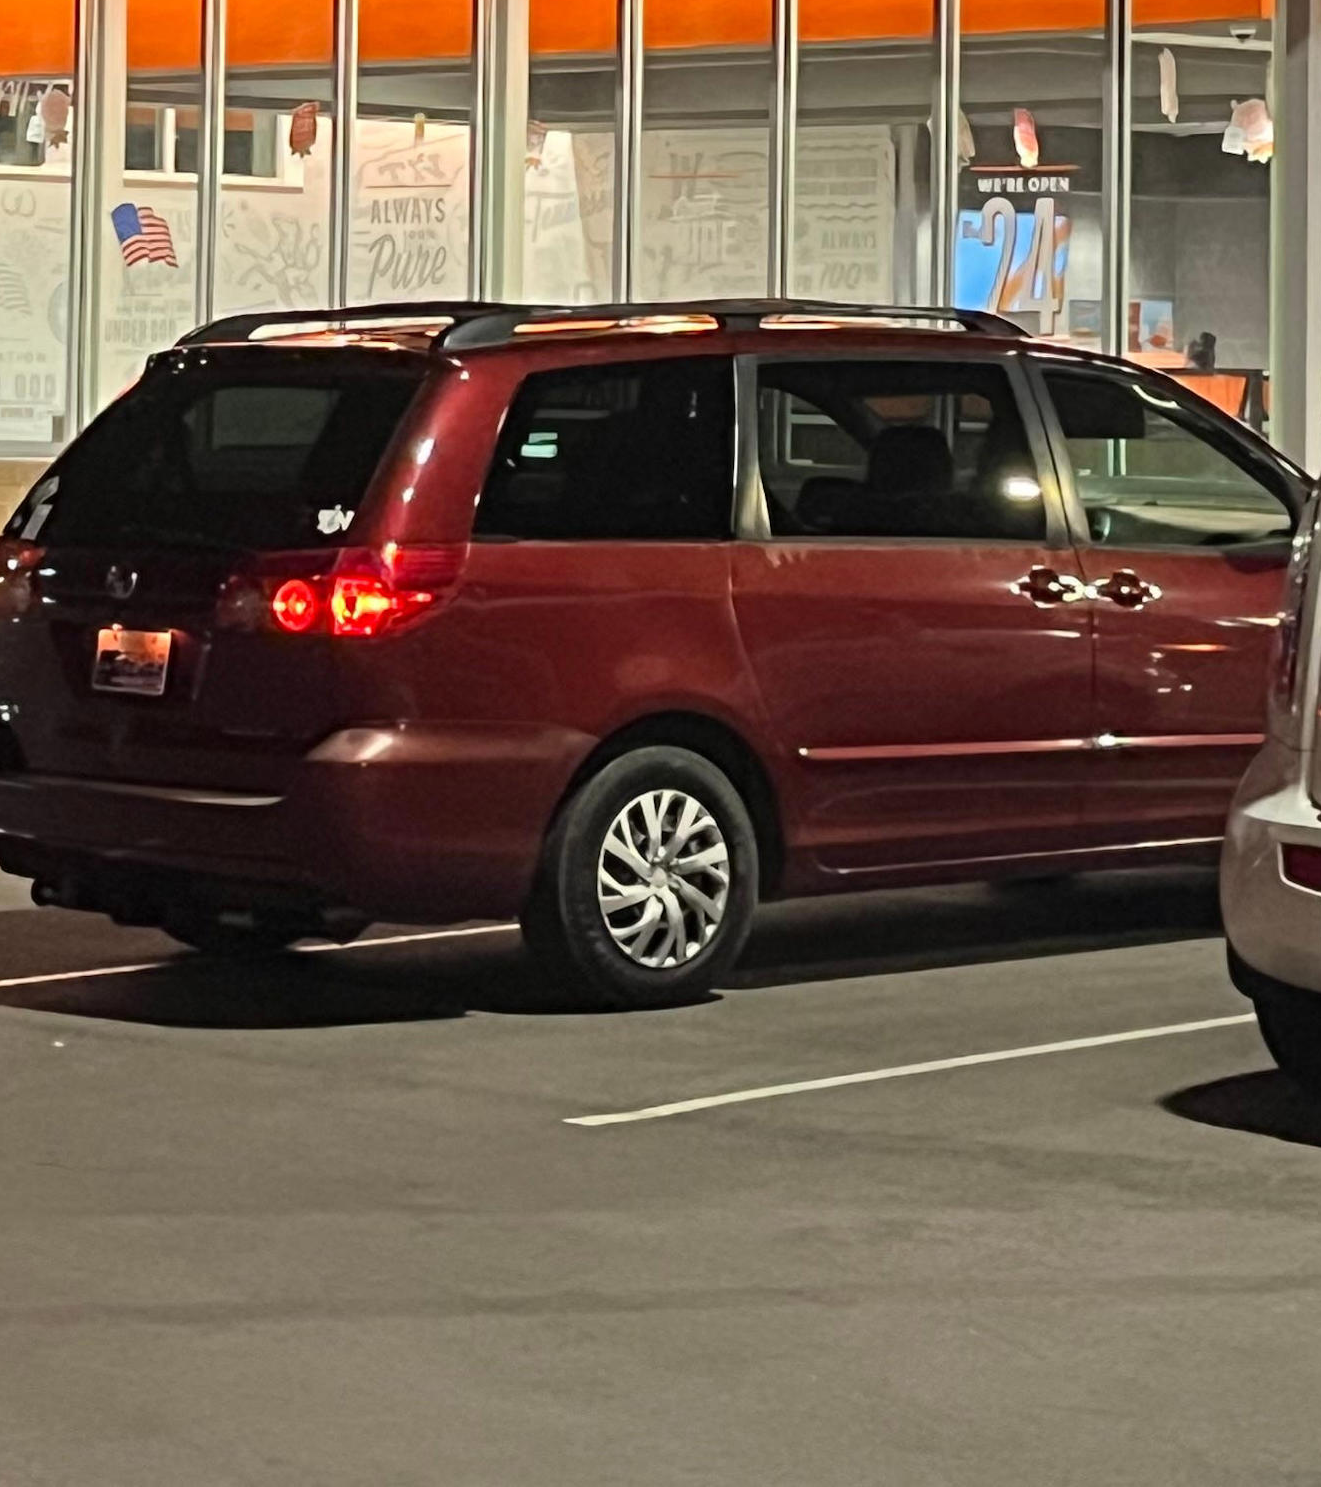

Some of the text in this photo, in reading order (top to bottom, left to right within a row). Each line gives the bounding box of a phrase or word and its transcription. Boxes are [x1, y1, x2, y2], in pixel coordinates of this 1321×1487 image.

[1028, 176, 1070, 192] OPEN
[370, 198, 447, 225] ALWAYS
[367, 233, 447, 301] Pure
[981, 196, 1060, 336] 24
